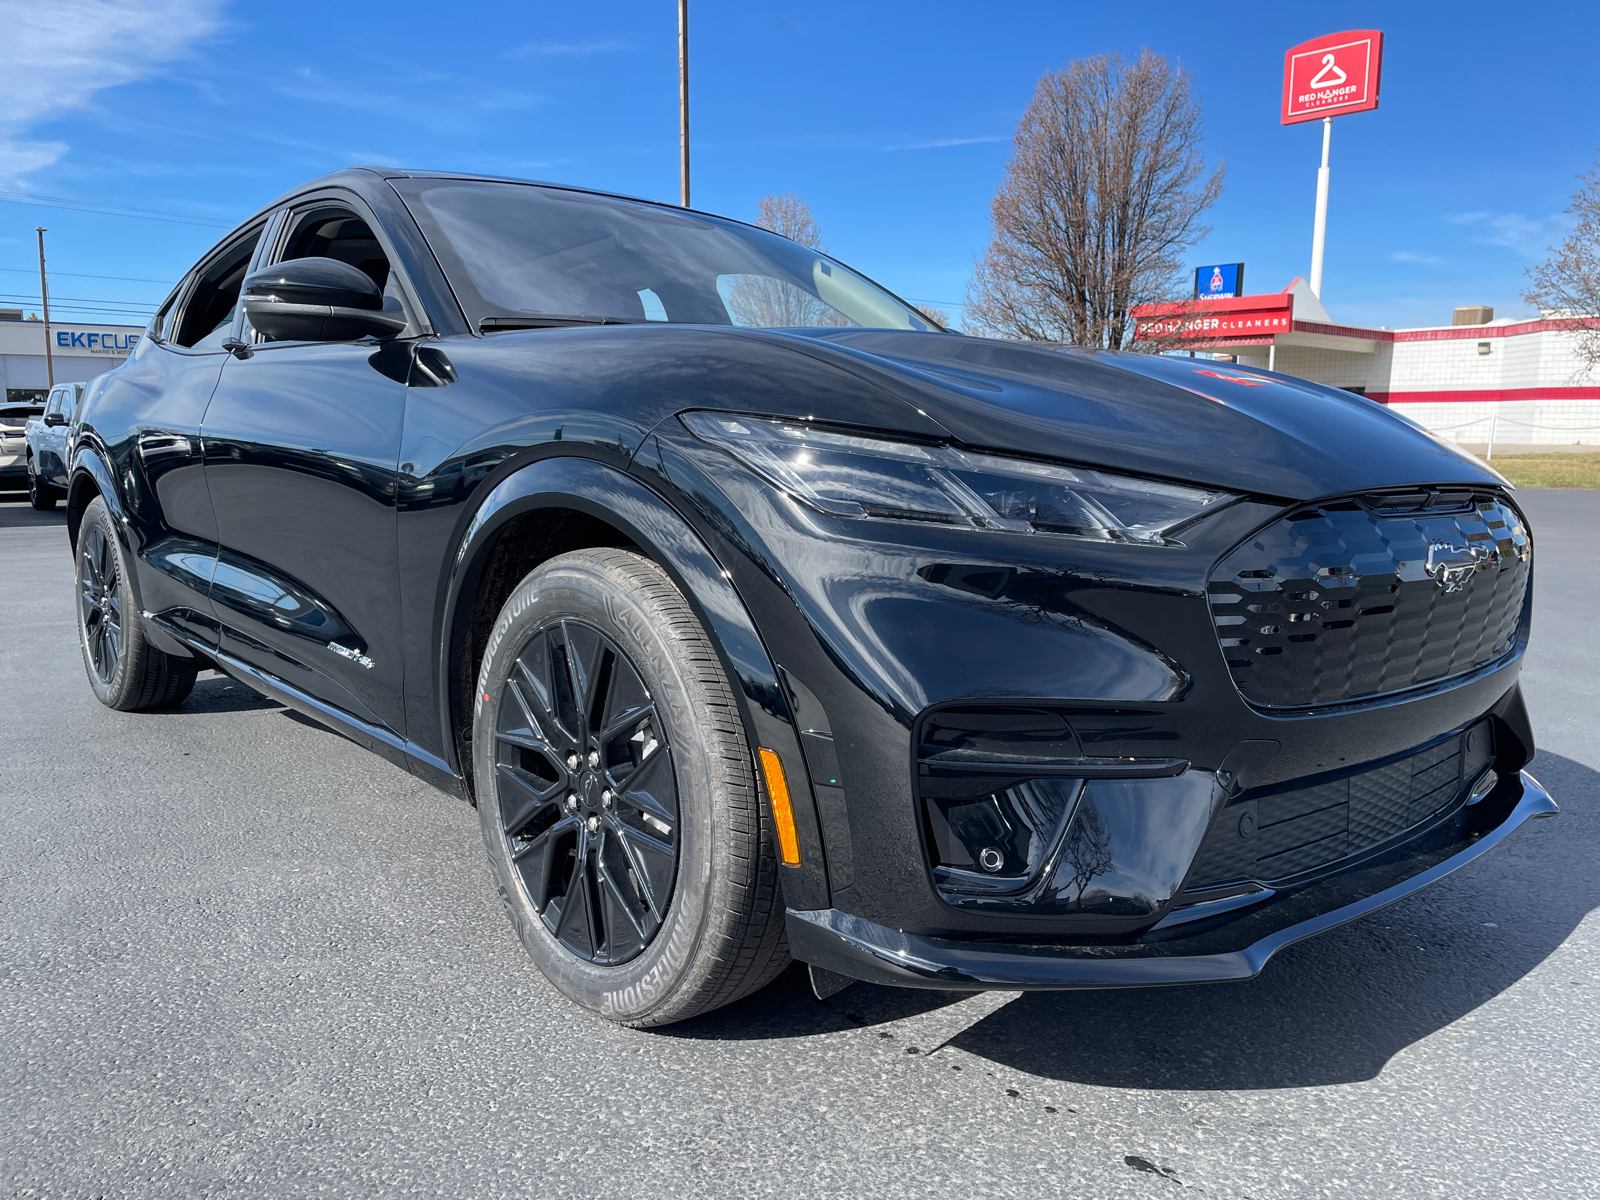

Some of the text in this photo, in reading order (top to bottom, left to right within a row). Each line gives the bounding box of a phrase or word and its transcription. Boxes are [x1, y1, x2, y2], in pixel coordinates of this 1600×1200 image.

[1299, 85, 1357, 103] RED HANGER
[1305, 95, 1349, 107] CLEANERS
[1222, 318, 1287, 329] CLEANERS
[100, 510, 123, 590] BRIDGESTONE
[475, 583, 539, 717] BRIDGESTONE
[619, 608, 688, 725] ALENZA
[602, 888, 693, 1015] BRIDGESTONE
